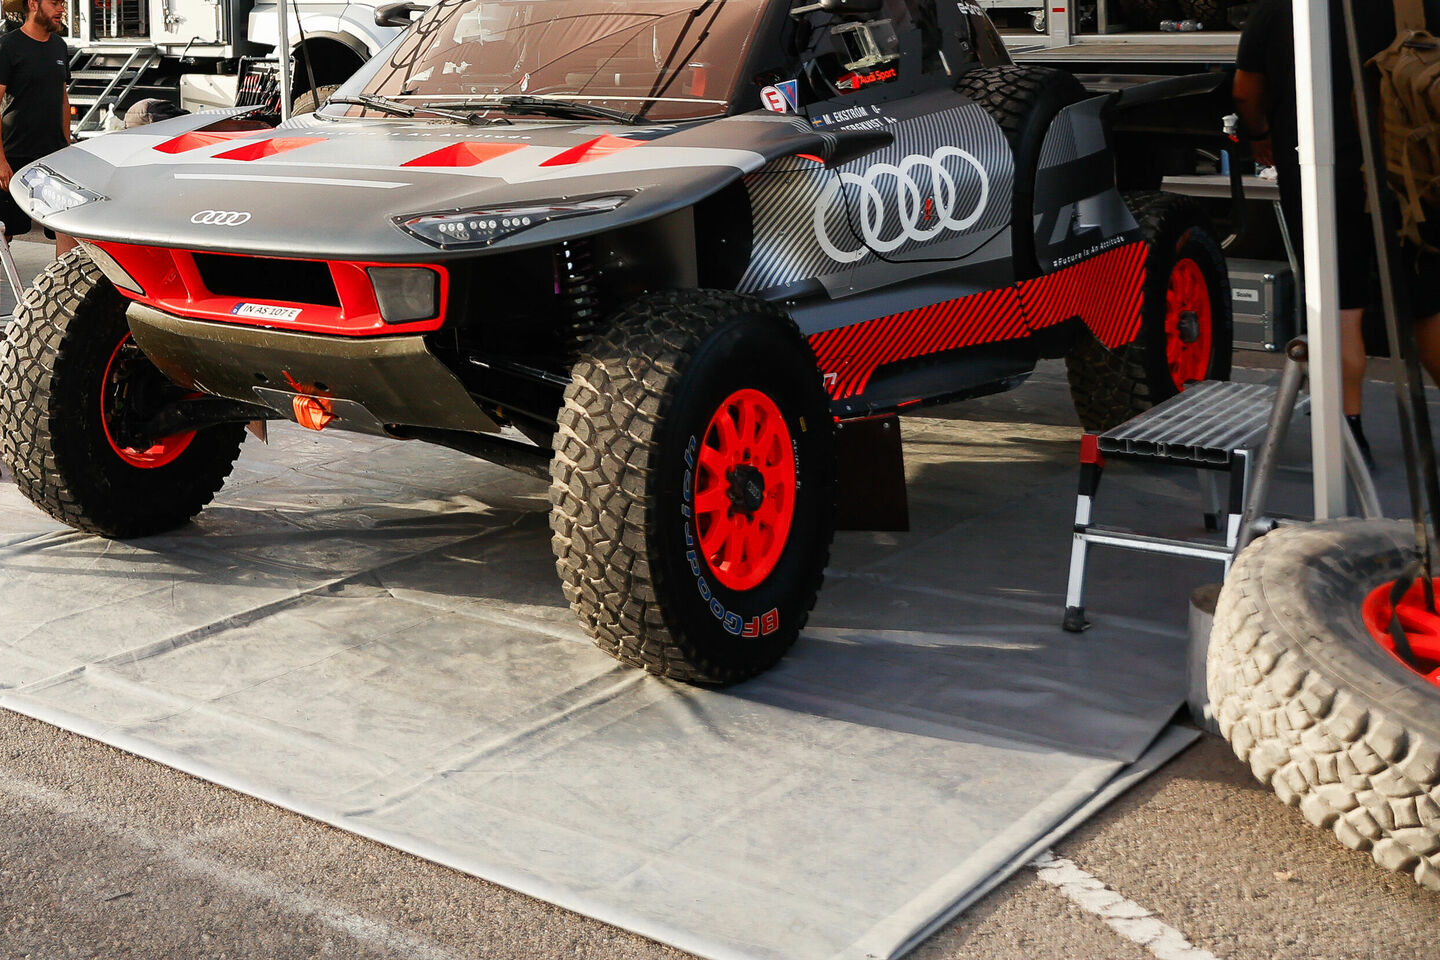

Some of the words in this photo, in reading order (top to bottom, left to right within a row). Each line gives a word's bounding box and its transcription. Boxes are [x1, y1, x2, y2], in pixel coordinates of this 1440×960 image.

[860, 73, 876, 84] Audi
[876, 68, 897, 82] Sport
[765, 91, 783, 112] E
[822, 114, 835, 125] M.
[833, 105, 869, 123] EKSTRÖM
[243, 305, 255, 313] IN
[255, 306, 269, 315] AS
[269, 308, 289, 316] 107
[287, 309, 297, 318] E
[681, 434, 779, 638] BFGoodrich
